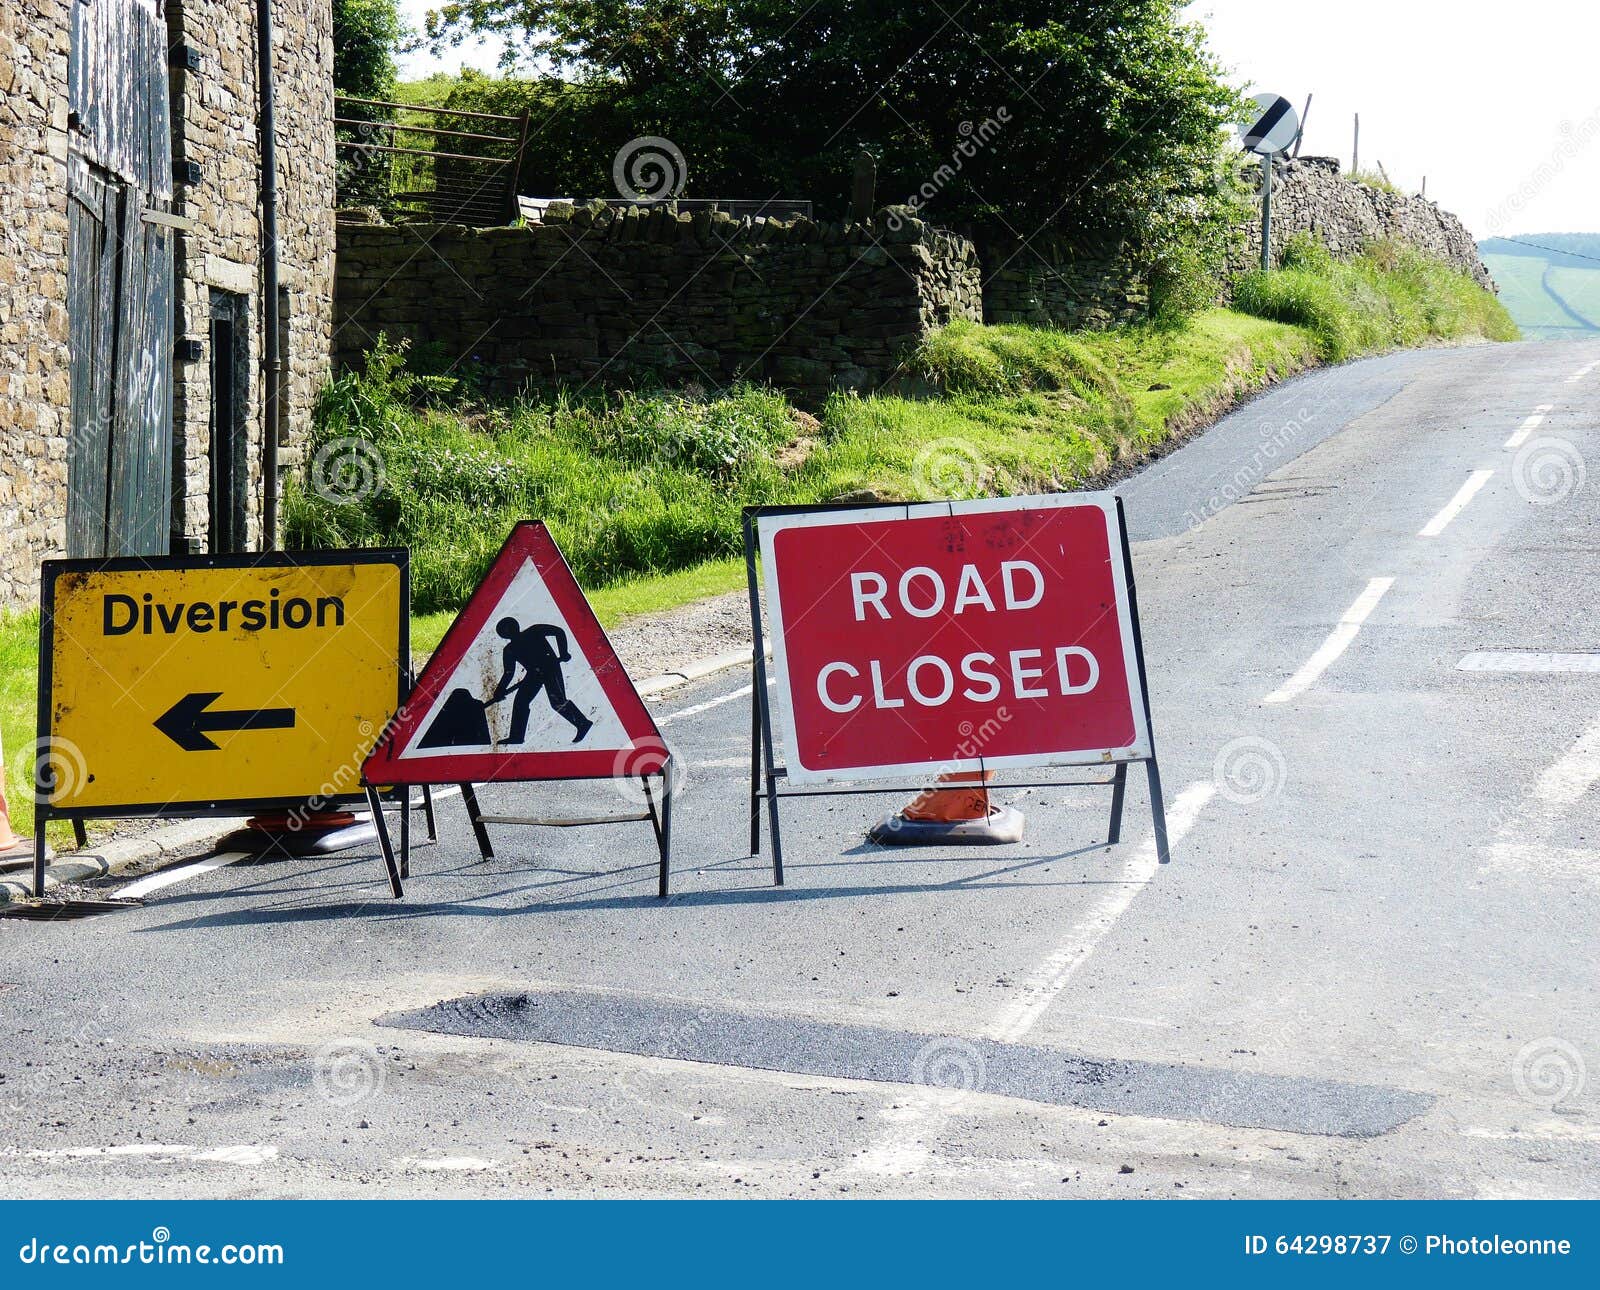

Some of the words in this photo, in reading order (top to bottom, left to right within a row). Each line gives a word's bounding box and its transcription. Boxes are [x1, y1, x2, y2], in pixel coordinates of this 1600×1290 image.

[103, 587, 345, 636] Diversion
[850, 560, 1045, 621] ROAD
[816, 645, 1100, 713] CLOSED
